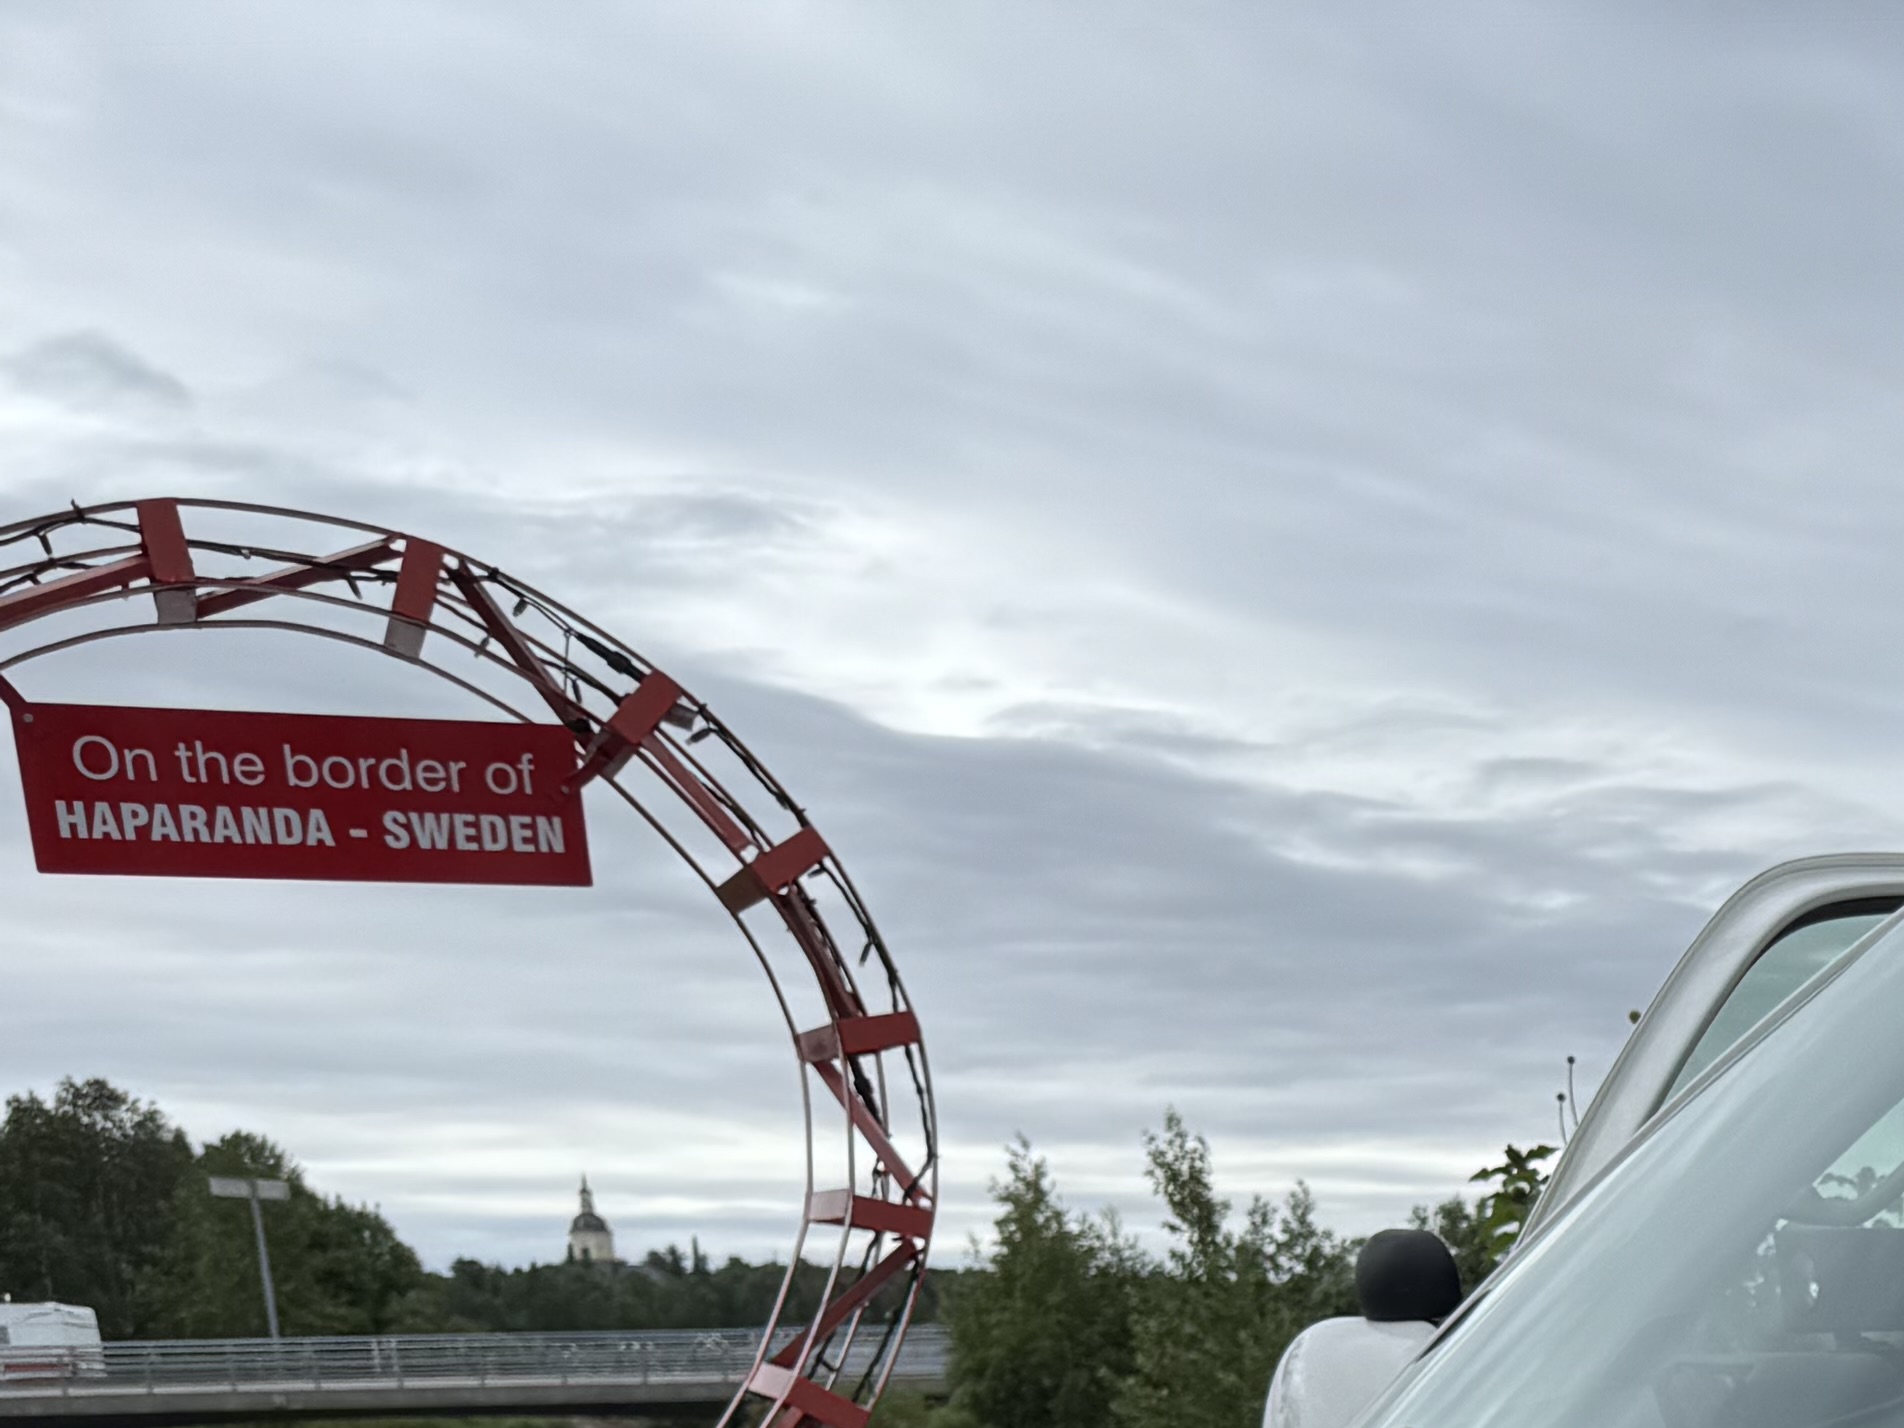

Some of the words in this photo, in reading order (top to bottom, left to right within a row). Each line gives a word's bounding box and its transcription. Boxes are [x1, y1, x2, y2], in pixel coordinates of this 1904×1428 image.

[72, 734, 158, 783] On
[174, 740, 266, 787] the
[283, 743, 467, 793] border
[485, 753, 535, 795] of
[55, 799, 336, 847] HAPARANDA
[383, 811, 566, 853] SWEDEN
